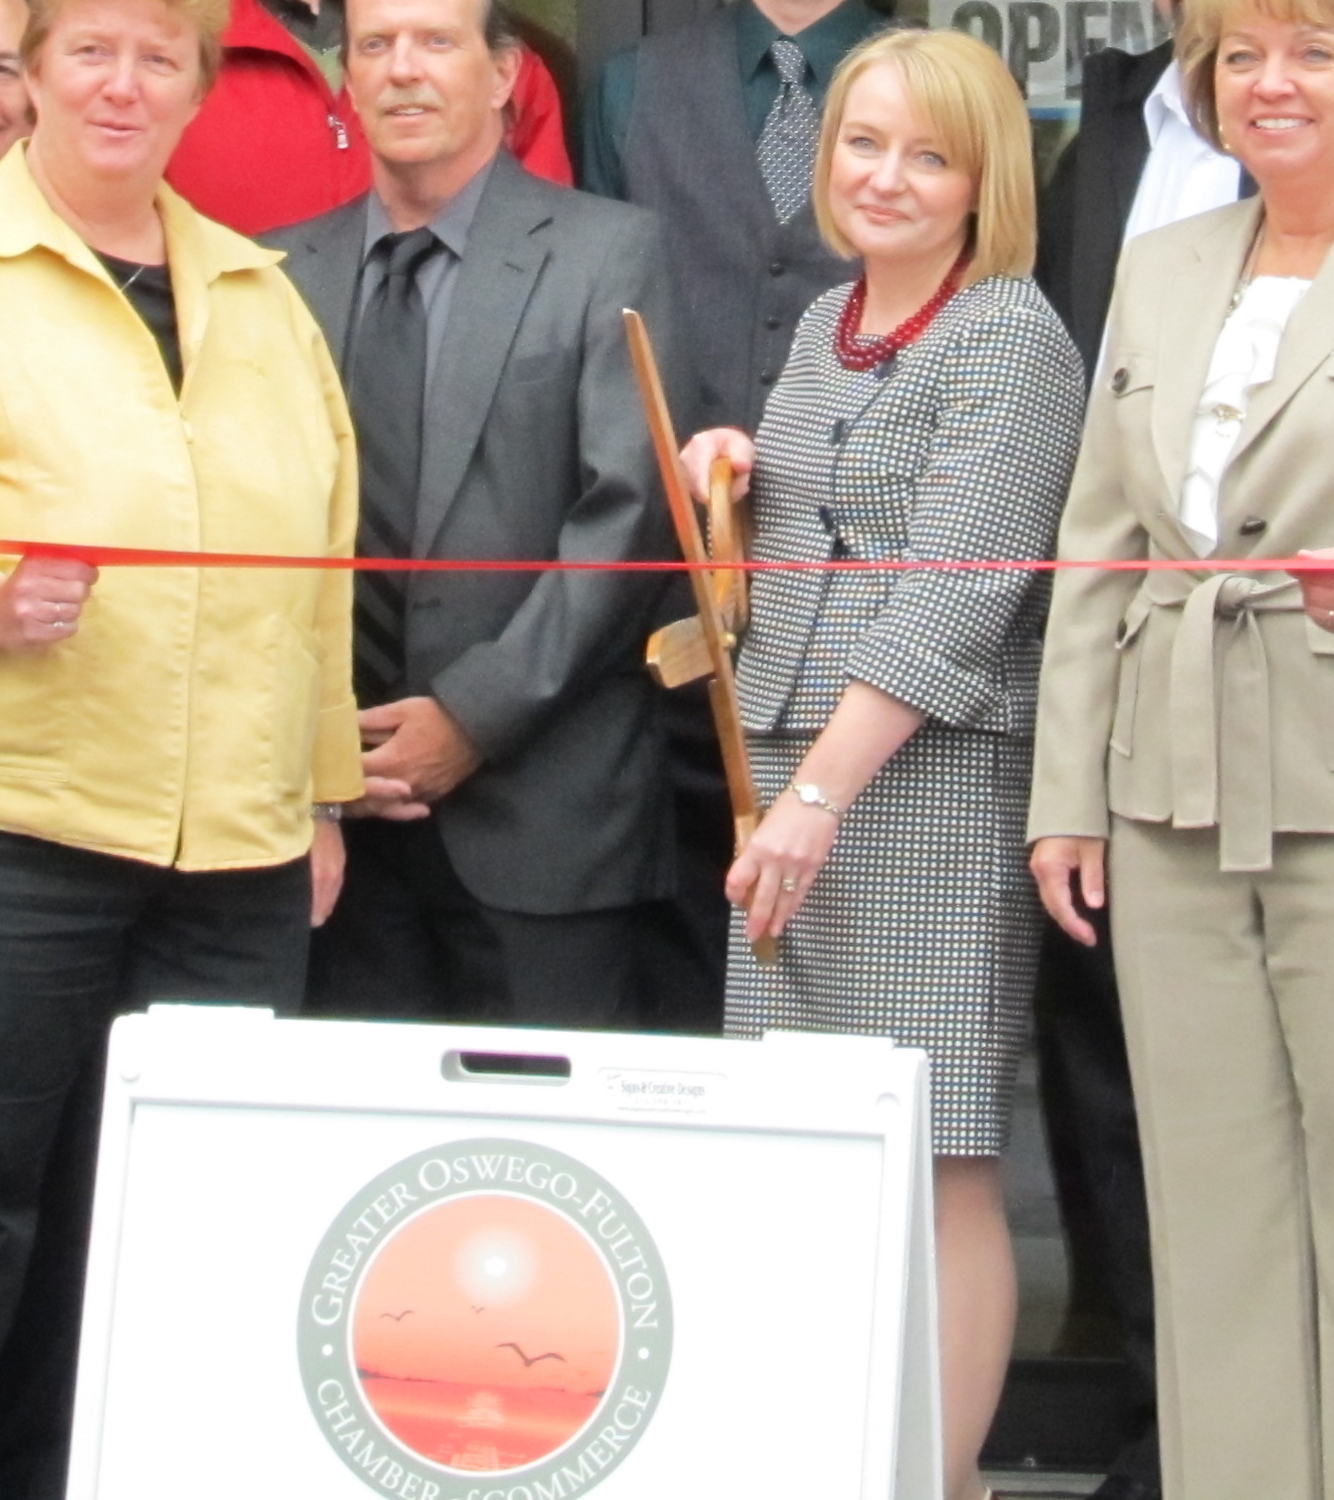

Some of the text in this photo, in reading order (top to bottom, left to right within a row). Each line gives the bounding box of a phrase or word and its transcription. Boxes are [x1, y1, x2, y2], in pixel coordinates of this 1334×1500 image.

[311, 1154, 659, 1329] GREATER OSWEGO-FULTON
[317, 1378, 441, 1500] CHAMBER
